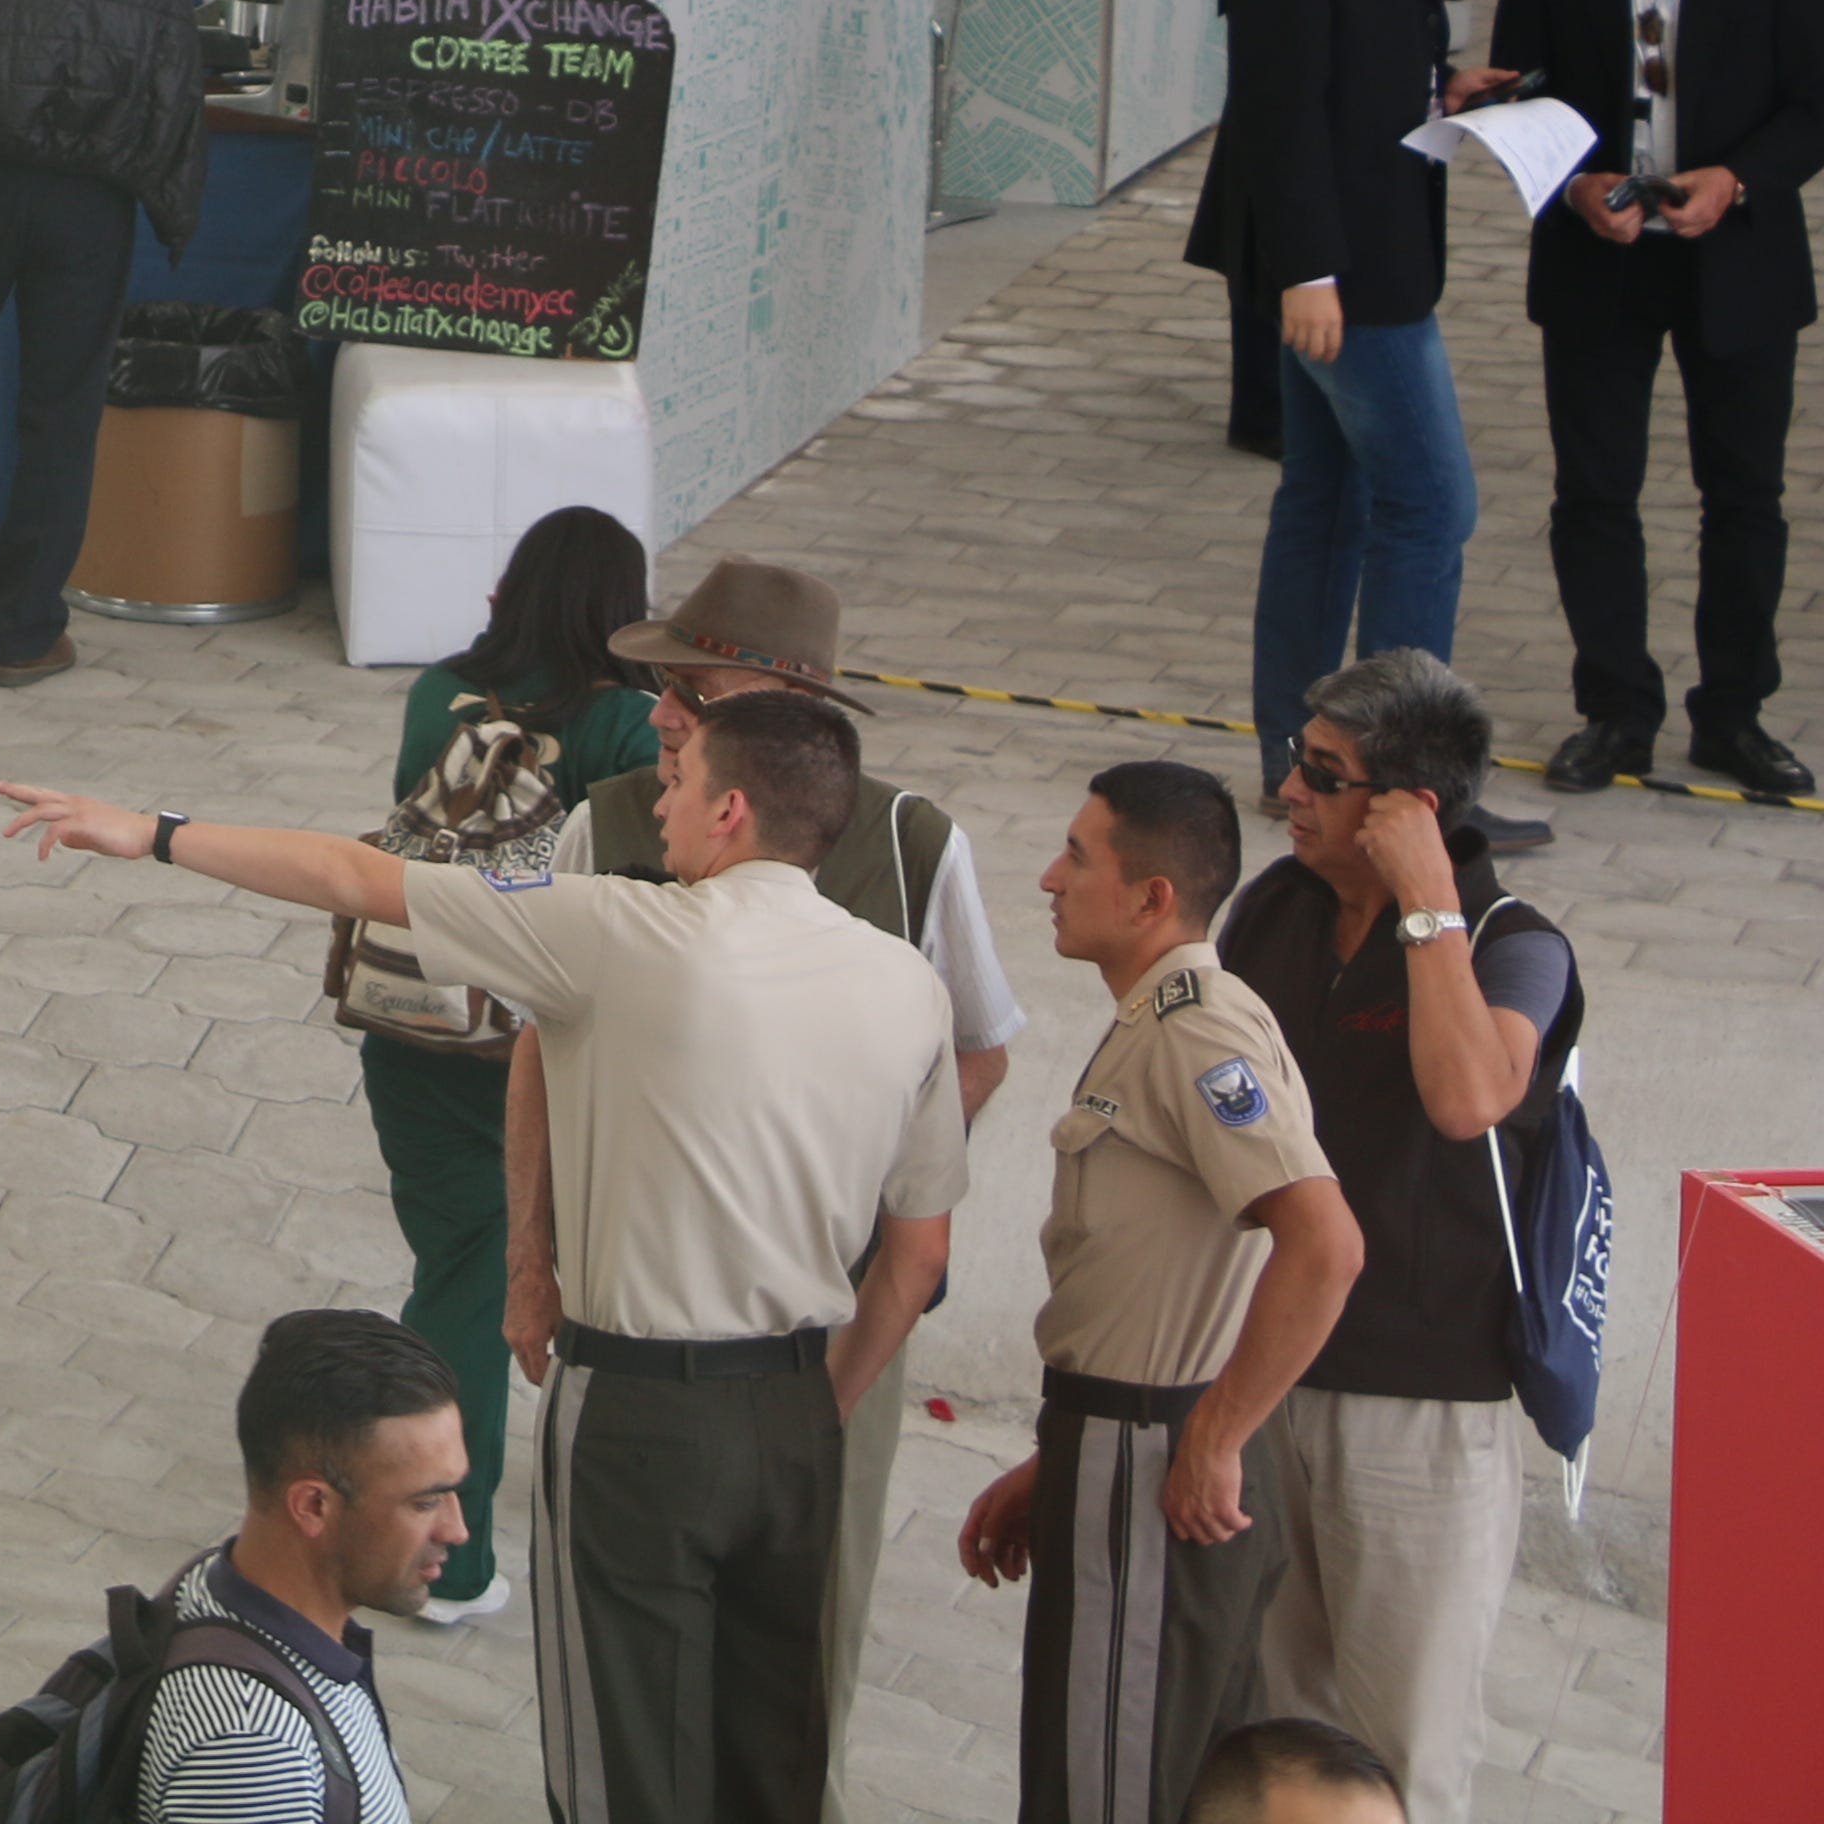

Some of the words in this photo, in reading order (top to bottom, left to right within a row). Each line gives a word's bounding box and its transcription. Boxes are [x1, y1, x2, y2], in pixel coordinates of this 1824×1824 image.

[410, 36, 530, 75] COFFEE
[545, 41, 635, 89] TEAM
[356, 78, 520, 116] ESPRESSO
